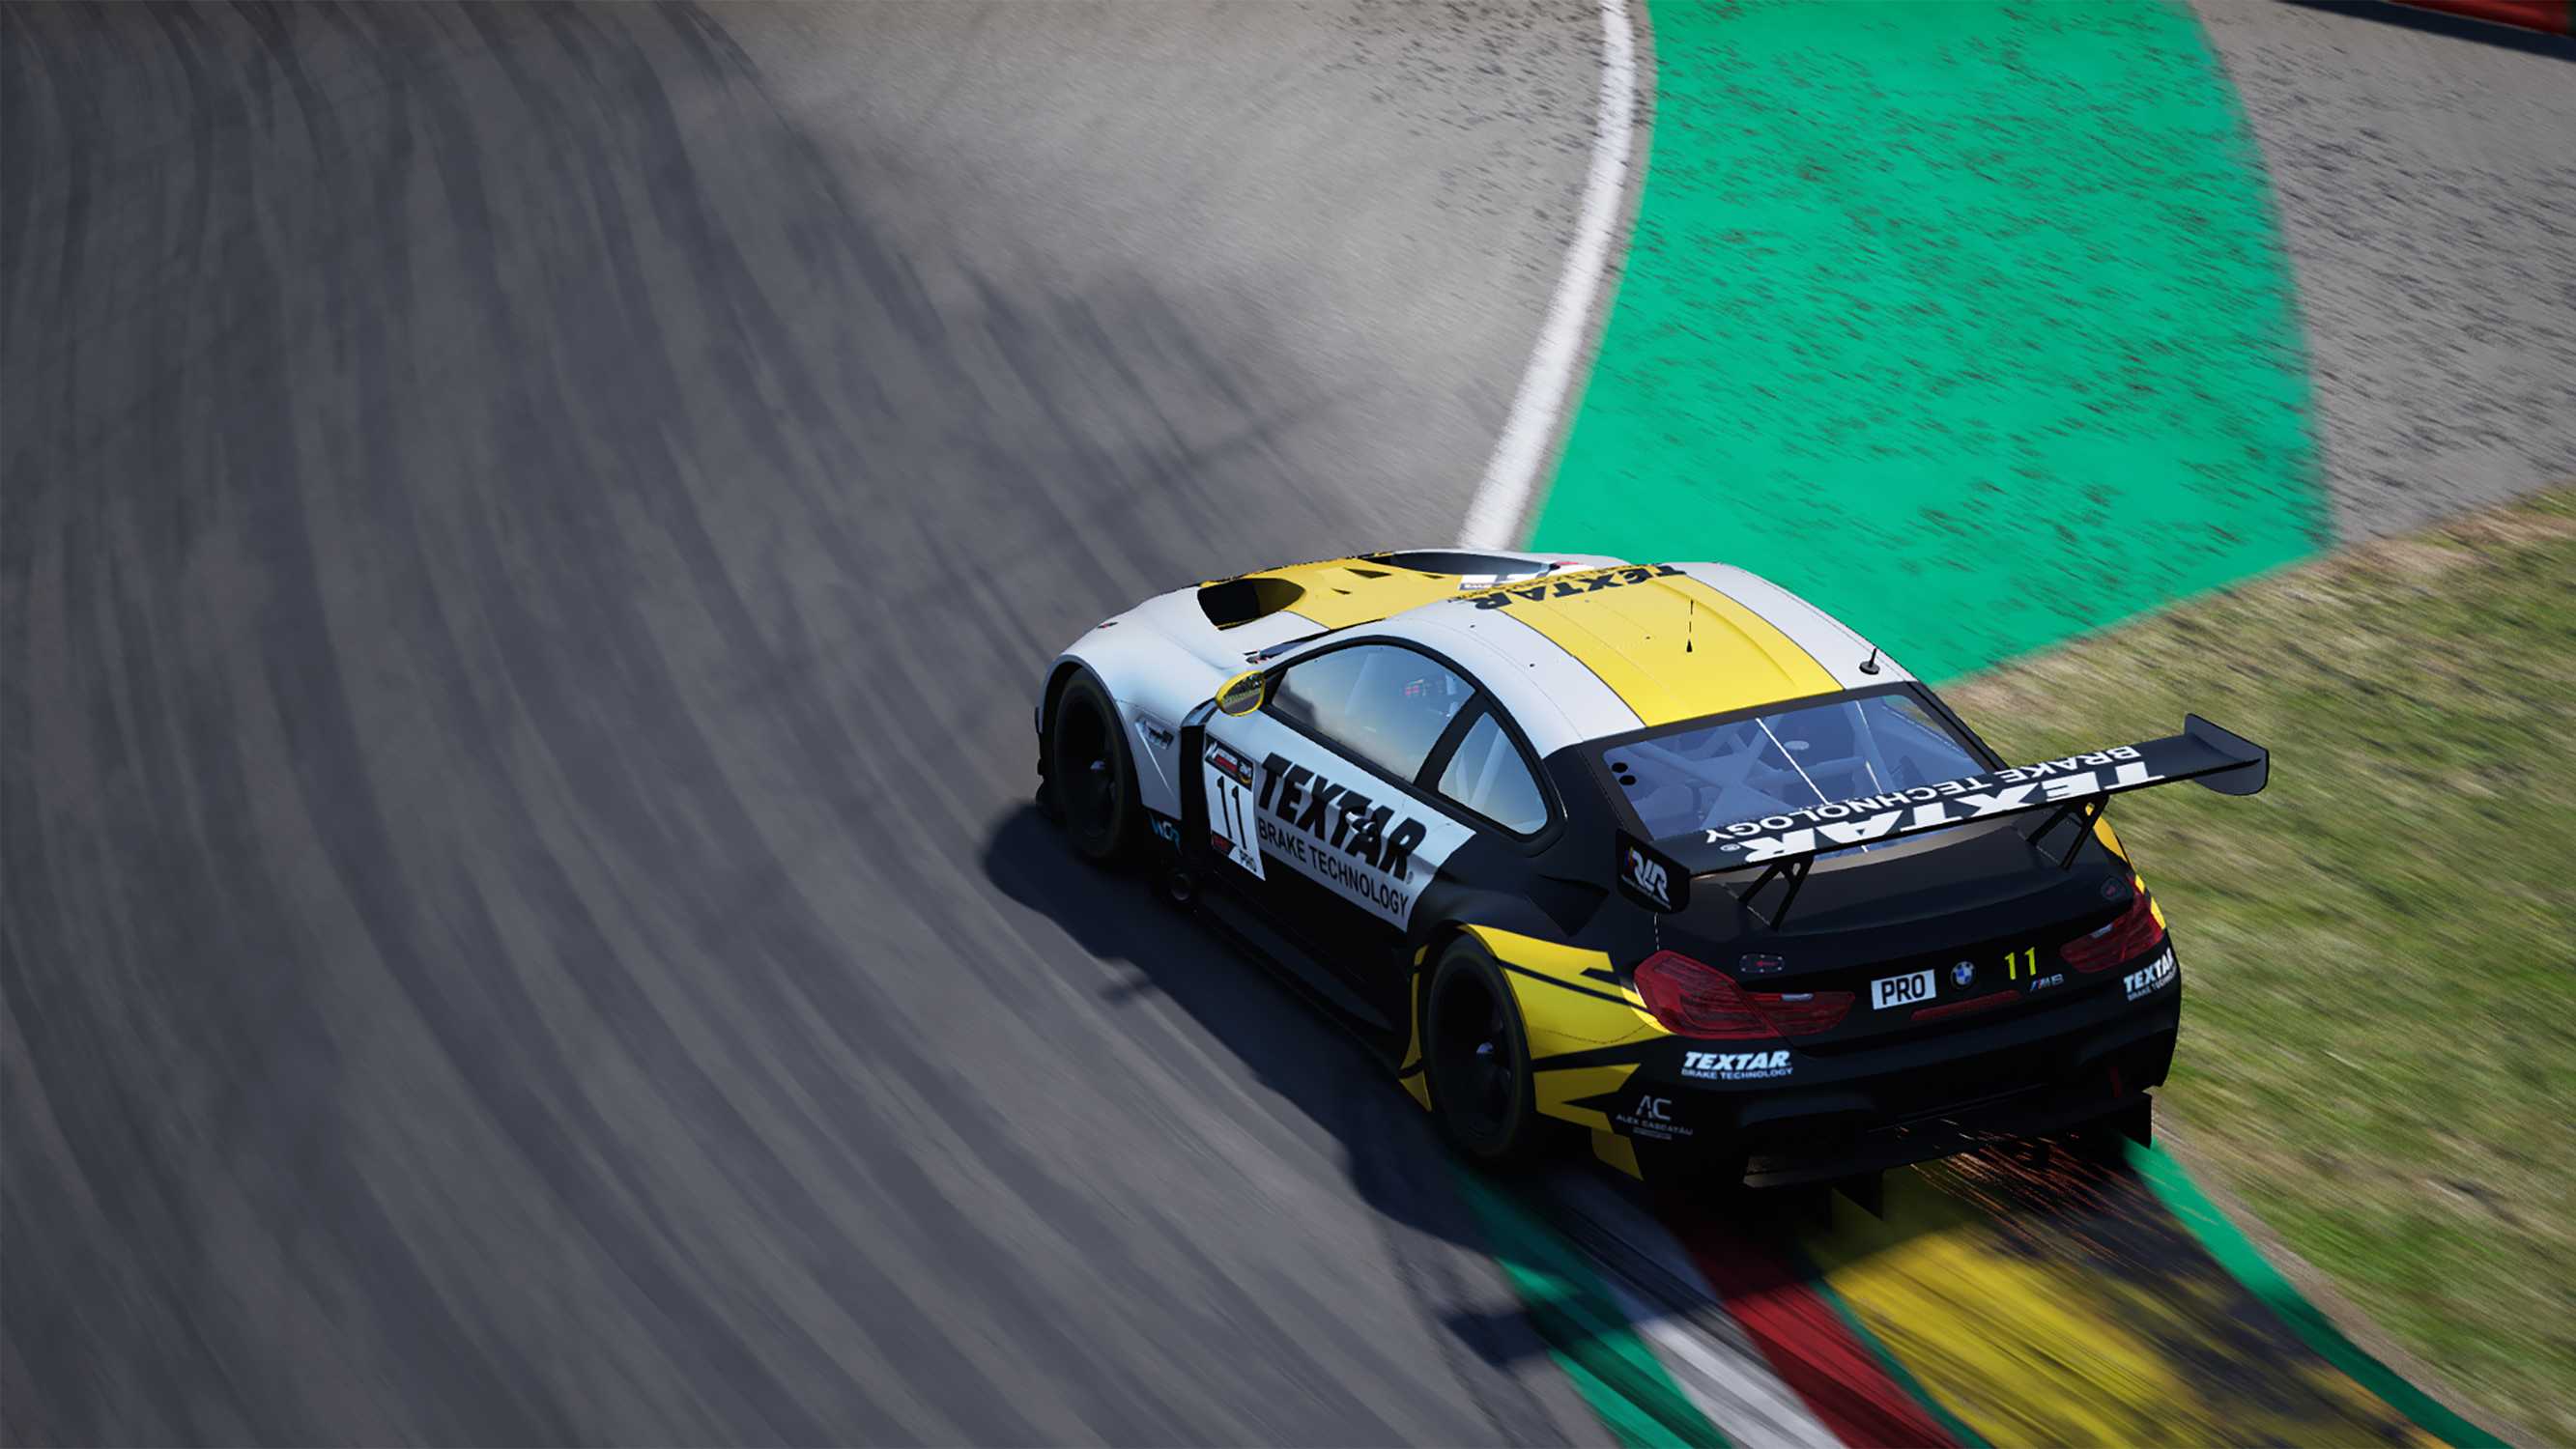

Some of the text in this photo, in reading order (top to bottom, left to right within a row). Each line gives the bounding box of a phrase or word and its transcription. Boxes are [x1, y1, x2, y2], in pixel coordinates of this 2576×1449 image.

[1474, 563, 1688, 611] TEXTAR
[1216, 776, 1247, 851] 11
[1258, 752, 1427, 882] TEXTAR
[1705, 745, 2142, 844] BRAKE TECHNOLOGY
[1740, 761, 2164, 863] TEXTAR
[1258, 817, 1409, 917] BRAKE TECHNOLOGY
[1880, 974, 1926, 1006] PRO
[2003, 947, 2037, 980] 11
[1681, 1066, 1793, 1080] BRAKE TECHNOLOGY
[1683, 1050, 1790, 1071] TEXTAR
